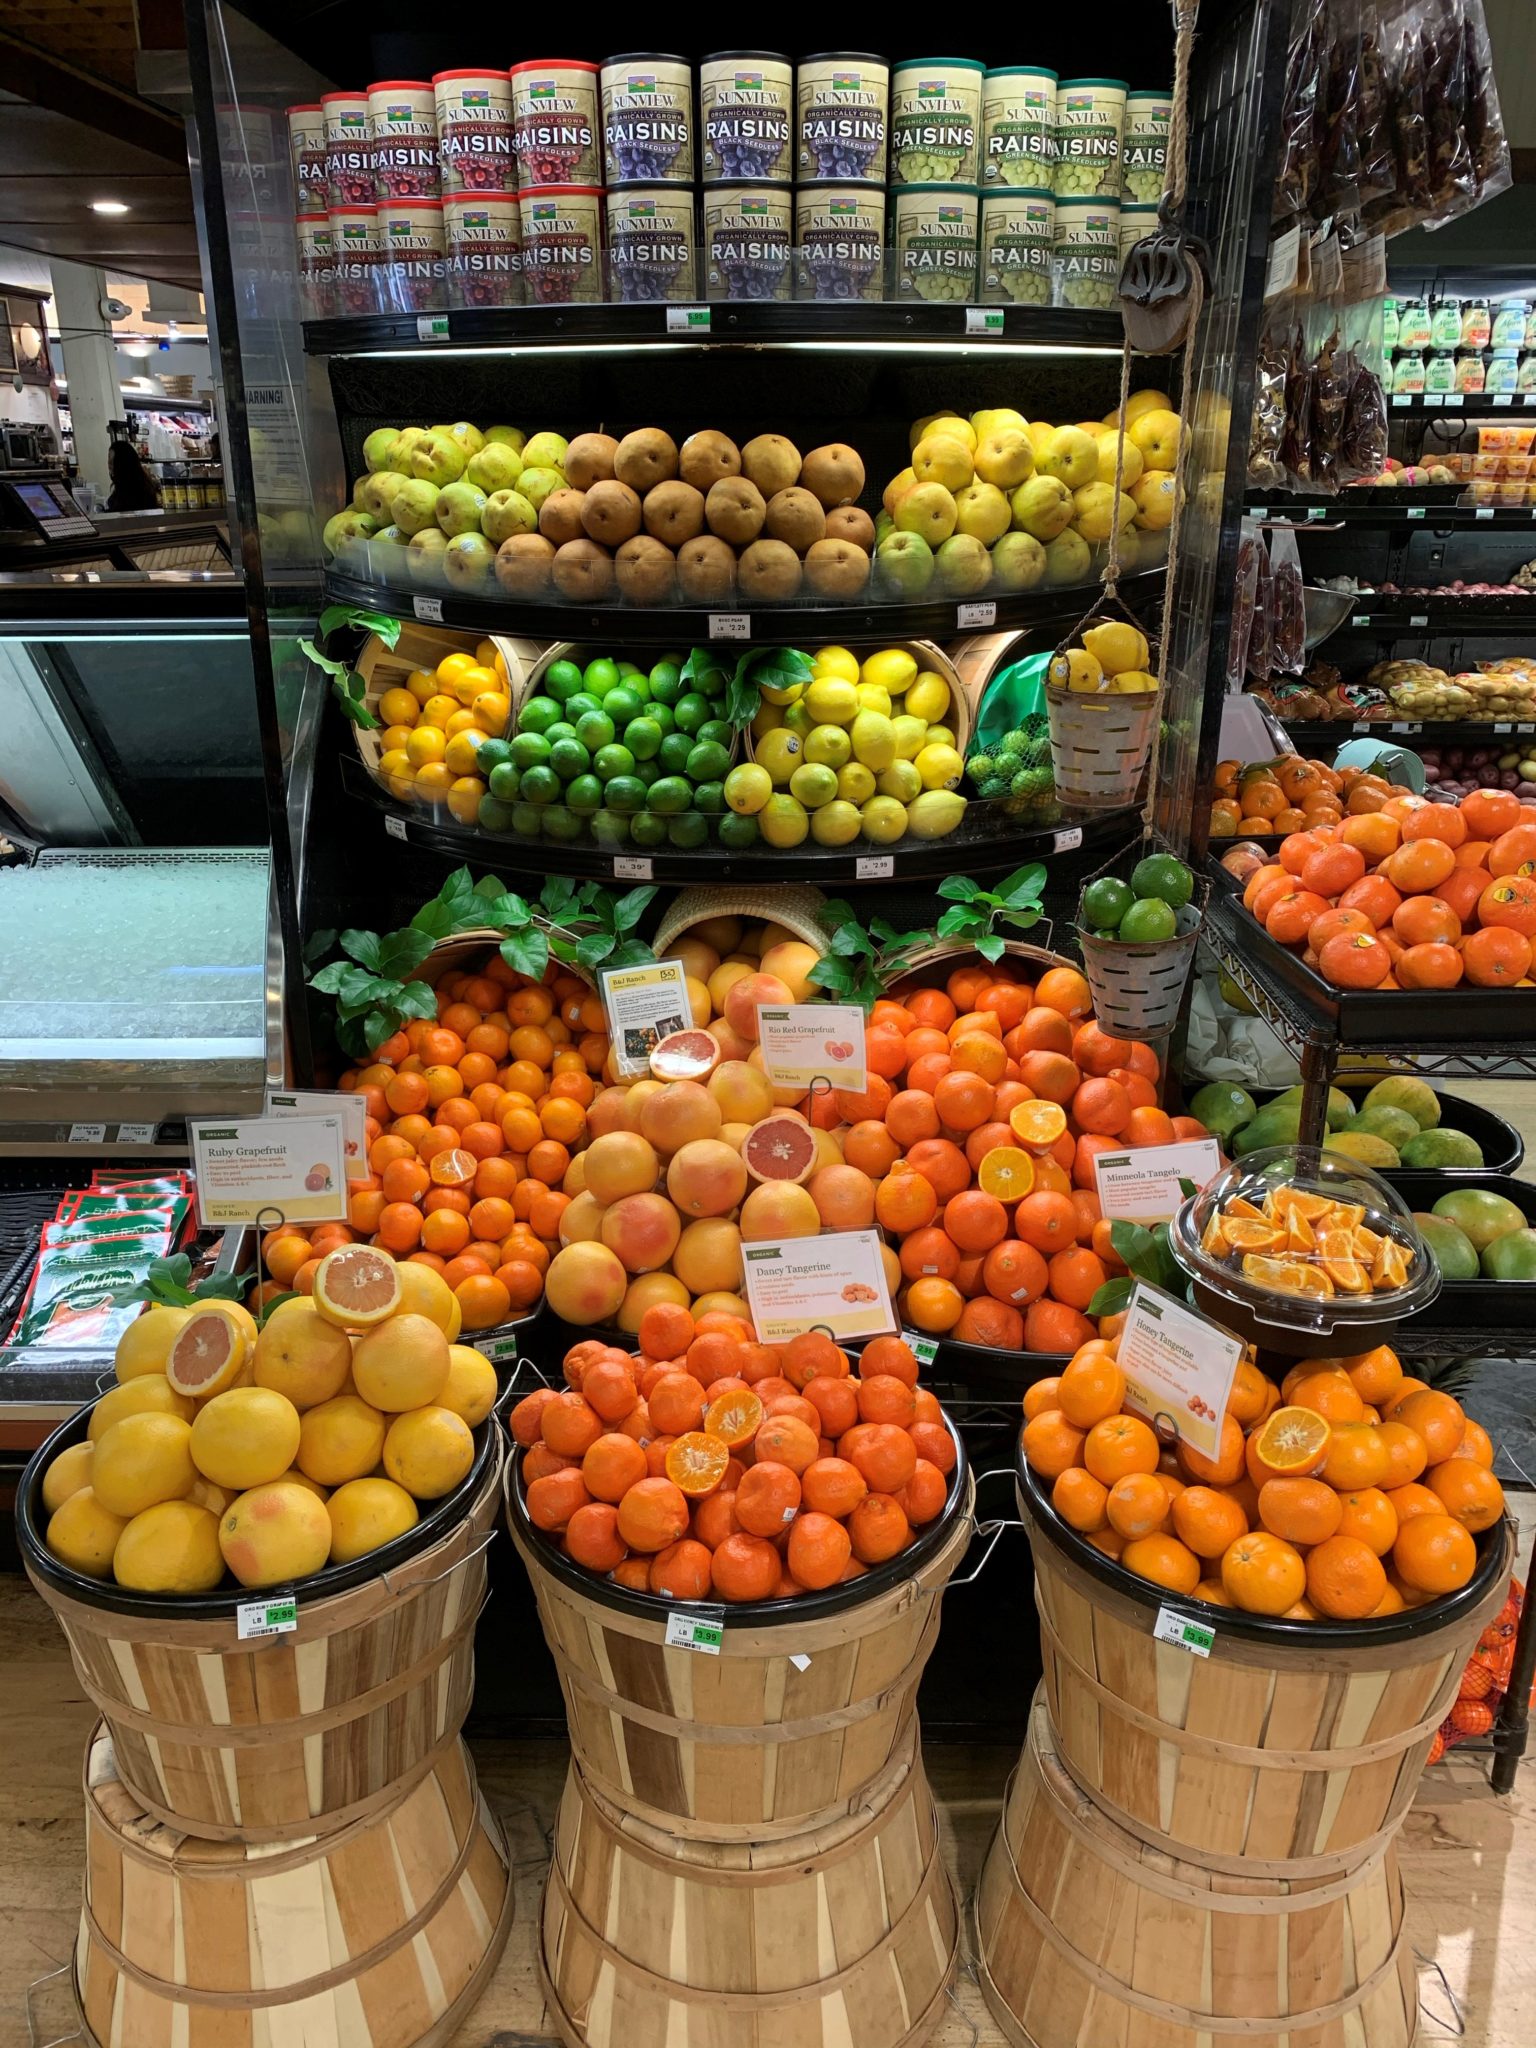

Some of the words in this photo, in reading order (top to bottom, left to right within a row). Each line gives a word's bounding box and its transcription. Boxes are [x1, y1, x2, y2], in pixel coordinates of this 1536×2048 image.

[614, 94, 675, 109] SUNVIEW
[718, 91, 780, 105] SUNVIEW
[815, 91, 877, 105] SUNVIEW
[519, 98, 577, 114] SUNVIEW
[903, 99, 965, 113] SUNVIEW
[449, 108, 508, 122] SUNVIEW
[608, 113, 654, 123] ORGANICALLY
[656, 113, 682, 121] GROWN
[710, 109, 760, 118] ORGANICALLY
[762, 109, 785, 119] GROWN
[808, 109, 858, 118] ORGANICALLY
[860, 110, 882, 119] GROWN
[1055, 112, 1110, 125] UNVIEW
[330, 128, 371, 141] SUNVIE
[377, 123, 433, 136] SUNVIEW
[606, 122, 688, 144] RAISINS
[707, 119, 789, 140] RAISINS
[802, 119, 884, 141] RAISINS
[1134, 122, 1169, 134] SUNVI
[515, 127, 592, 149] RAISINS
[744, 138, 779, 150] SEEDLESS
[815, 137, 838, 145] BLACK
[841, 138, 875, 150] SEEDLESS
[893, 127, 974, 148] RAISINS
[536, 145, 577, 156] SEEDLESS
[616, 141, 637, 149] BLACK
[639, 142, 676, 152] SEEDLESS
[902, 145, 923, 153] GREEN
[925, 146, 961, 156] SEEDLESS
[1054, 138, 1118, 156] AISINS
[326, 152, 371, 171] RAISI
[469, 152, 509, 165] SEEDLESS
[1071, 155, 1105, 165] SEEDLESS
[1124, 148, 1165, 164] RAIS
[394, 165, 432, 177] SEEDLESS
[524, 220, 577, 235] SUNVIEW
[616, 217, 675, 232] SUNVIEW
[723, 216, 784, 230] SUNVIEW
[813, 216, 873, 229] SUNVIEW
[1007, 221, 1051, 235] SUNVIE
[452, 228, 509, 242] SUNVIEW
[716, 233, 765, 241] ORGANICALLY
[805, 233, 853, 241] ORGANICALLY
[919, 224, 973, 237] SUNVIEW
[910, 240, 959, 248] ORGANICALLY
[522, 246, 592, 265] RAISINS
[610, 244, 688, 263] RAISINS
[711, 243, 791, 260] RAISINS
[800, 243, 881, 261] RAISINS
[447, 254, 522, 272] RAISINS
[750, 260, 783, 271] SEEDLESS
[904, 250, 977, 269] RAISINS
[538, 265, 576, 274] SEEDLESS
[626, 974, 646, 984] Ranch
[768, 1025, 780, 1034] Rio
[781, 1025, 796, 1034] Red
[798, 1025, 836, 1036] Grapefruit
[208, 1146, 233, 1158] Ruby
[235, 1144, 288, 1157] Grapefruit
[1106, 1170, 1146, 1182] Minneola
[1147, 1167, 1181, 1180] Tangelo
[229, 1209, 250, 1217] Ranch
[62, 1224, 150, 1243] DUCKTRAP
[756, 1266, 784, 1278] Dancy
[785, 1262, 831, 1275] Tangerine
[1136, 1317, 1159, 1340] Honey
[1159, 1331, 1195, 1361] Tangerine
[252, 1617, 262, 1625] LB
[270, 1609, 293, 1620] $2.99
[678, 1628, 688, 1636] LB
[695, 1629, 717, 1641] $3.99
[1169, 1626, 1179, 1635] LB
[1187, 1630, 1209, 1646] $3.99
